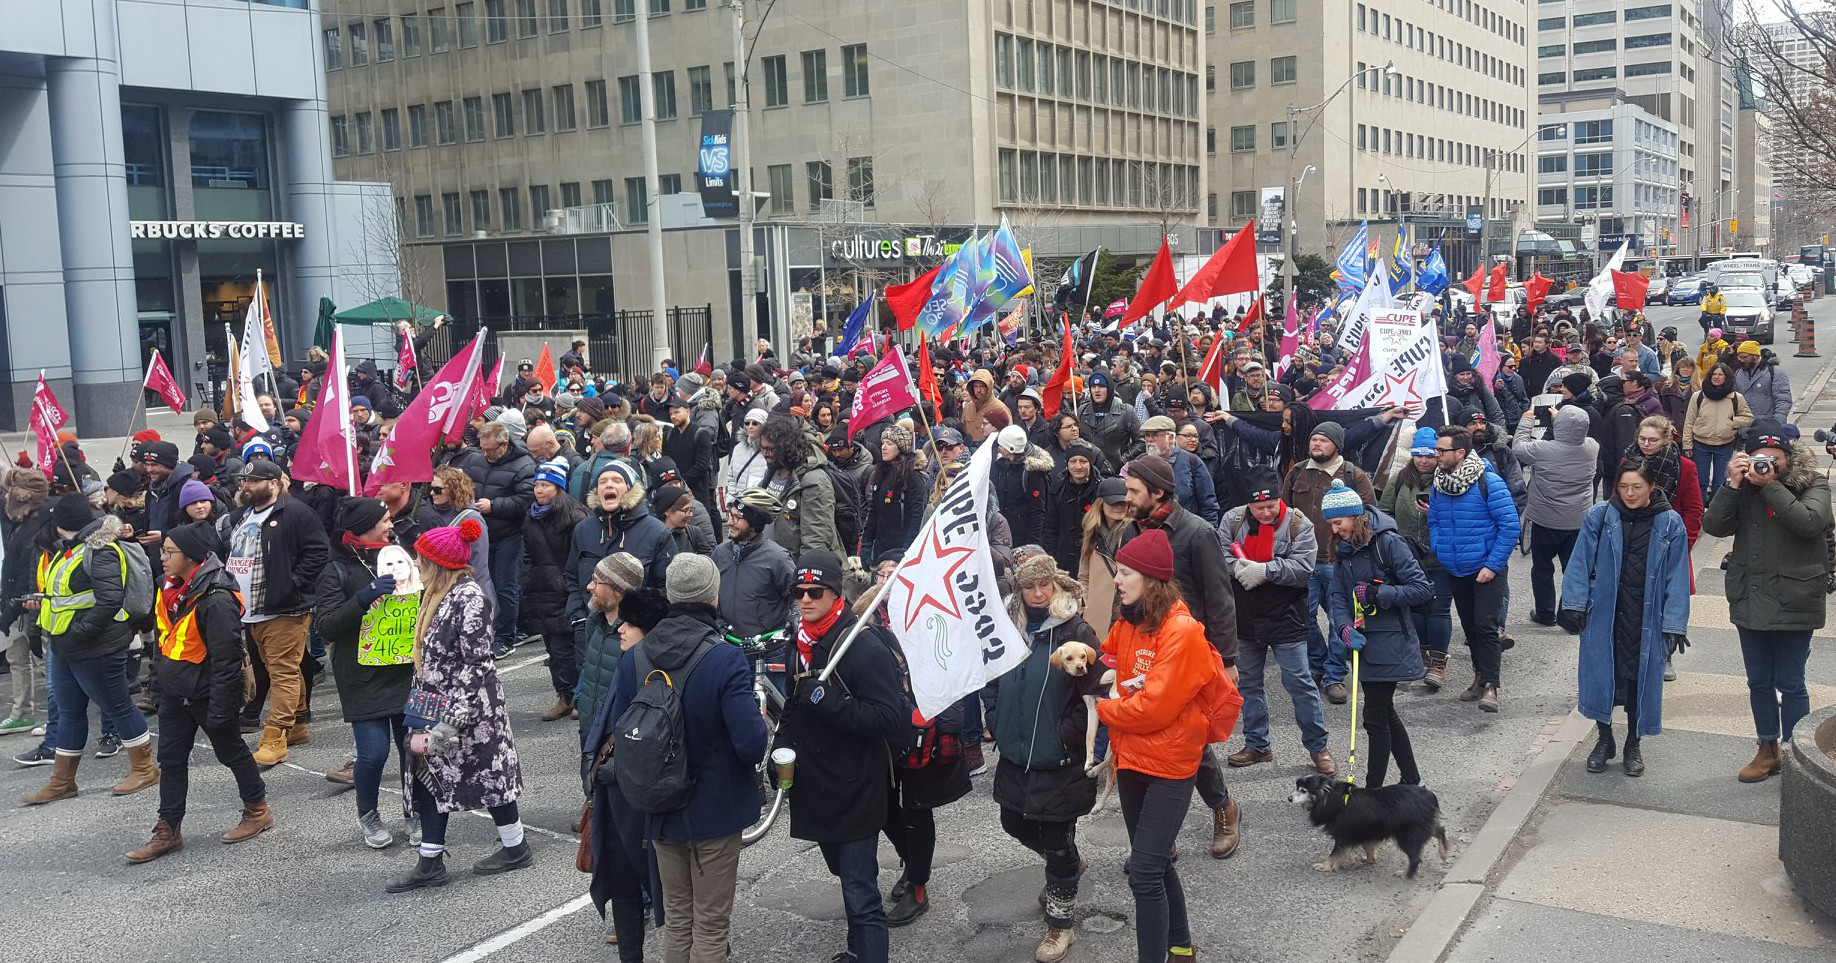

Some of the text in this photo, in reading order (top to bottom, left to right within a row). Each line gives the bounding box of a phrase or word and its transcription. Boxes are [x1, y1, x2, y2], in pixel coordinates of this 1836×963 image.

[700, 147, 729, 174] VS
[705, 176, 724, 187] Limits
[130, 223, 305, 239] RBUCKS COFFEE
[1386, 313, 1417, 324] CUPE
[940, 461, 980, 546] UPE
[383, 596, 418, 618] Com
[377, 616, 402, 637] Call
